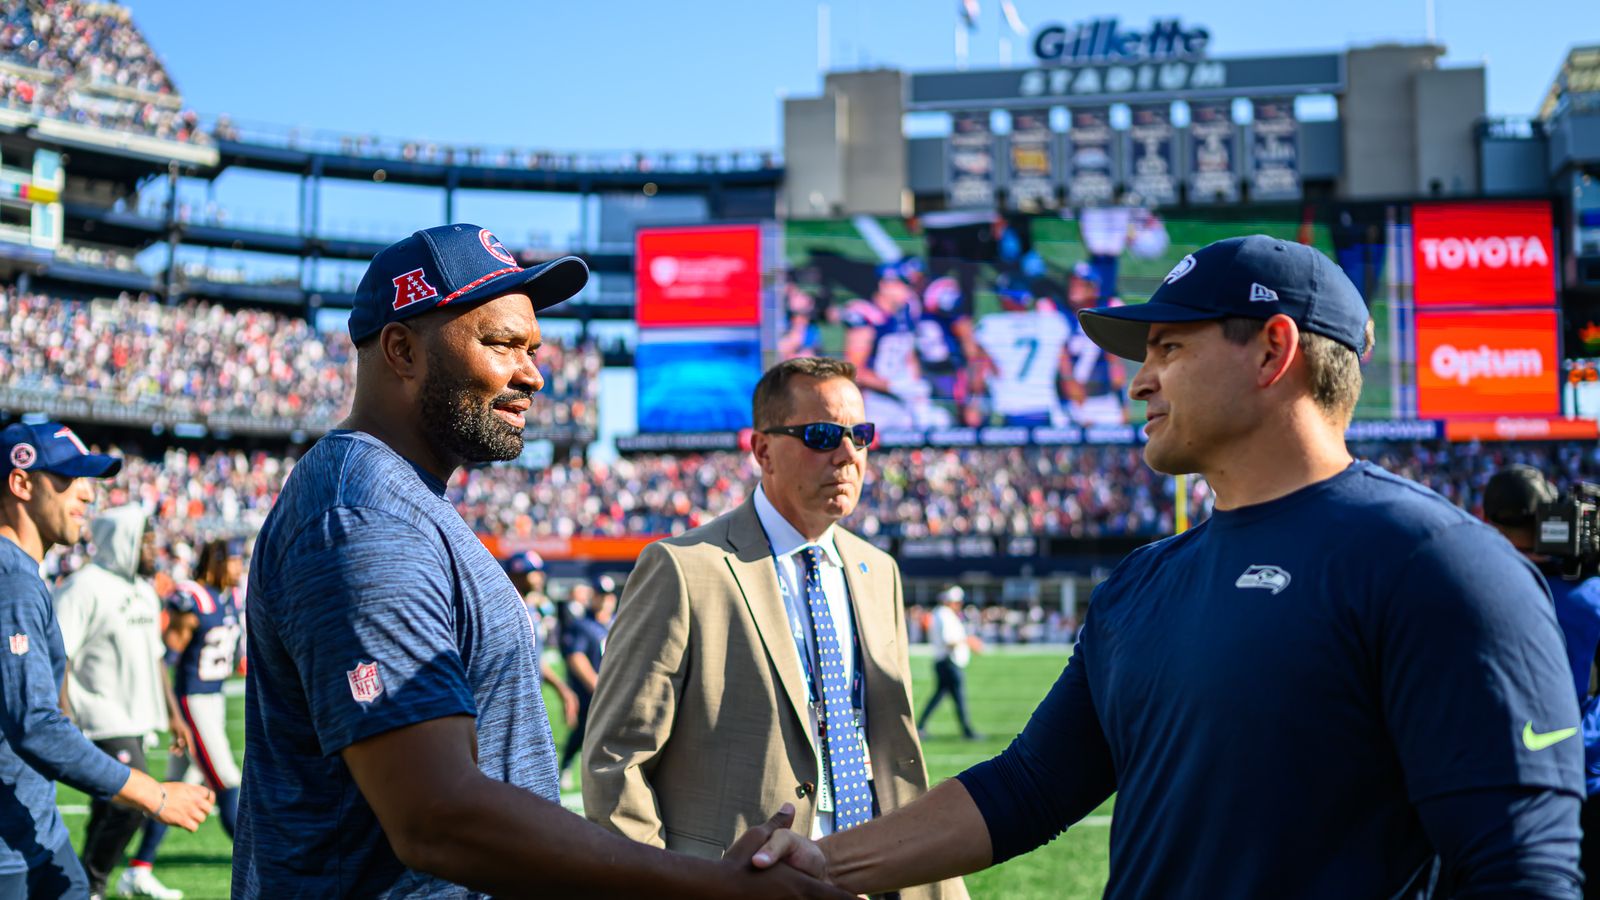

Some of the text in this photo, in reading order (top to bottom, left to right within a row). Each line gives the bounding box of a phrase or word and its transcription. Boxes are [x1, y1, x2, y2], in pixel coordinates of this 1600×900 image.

[1033, 18, 1210, 62] Gillette
[1020, 62, 1226, 96] STADIUM
[1420, 235, 1549, 270] TOYOTA
[1014, 335, 1038, 382] 7
[1431, 344, 1543, 386] Optum
[355, 677, 380, 696] NFL
